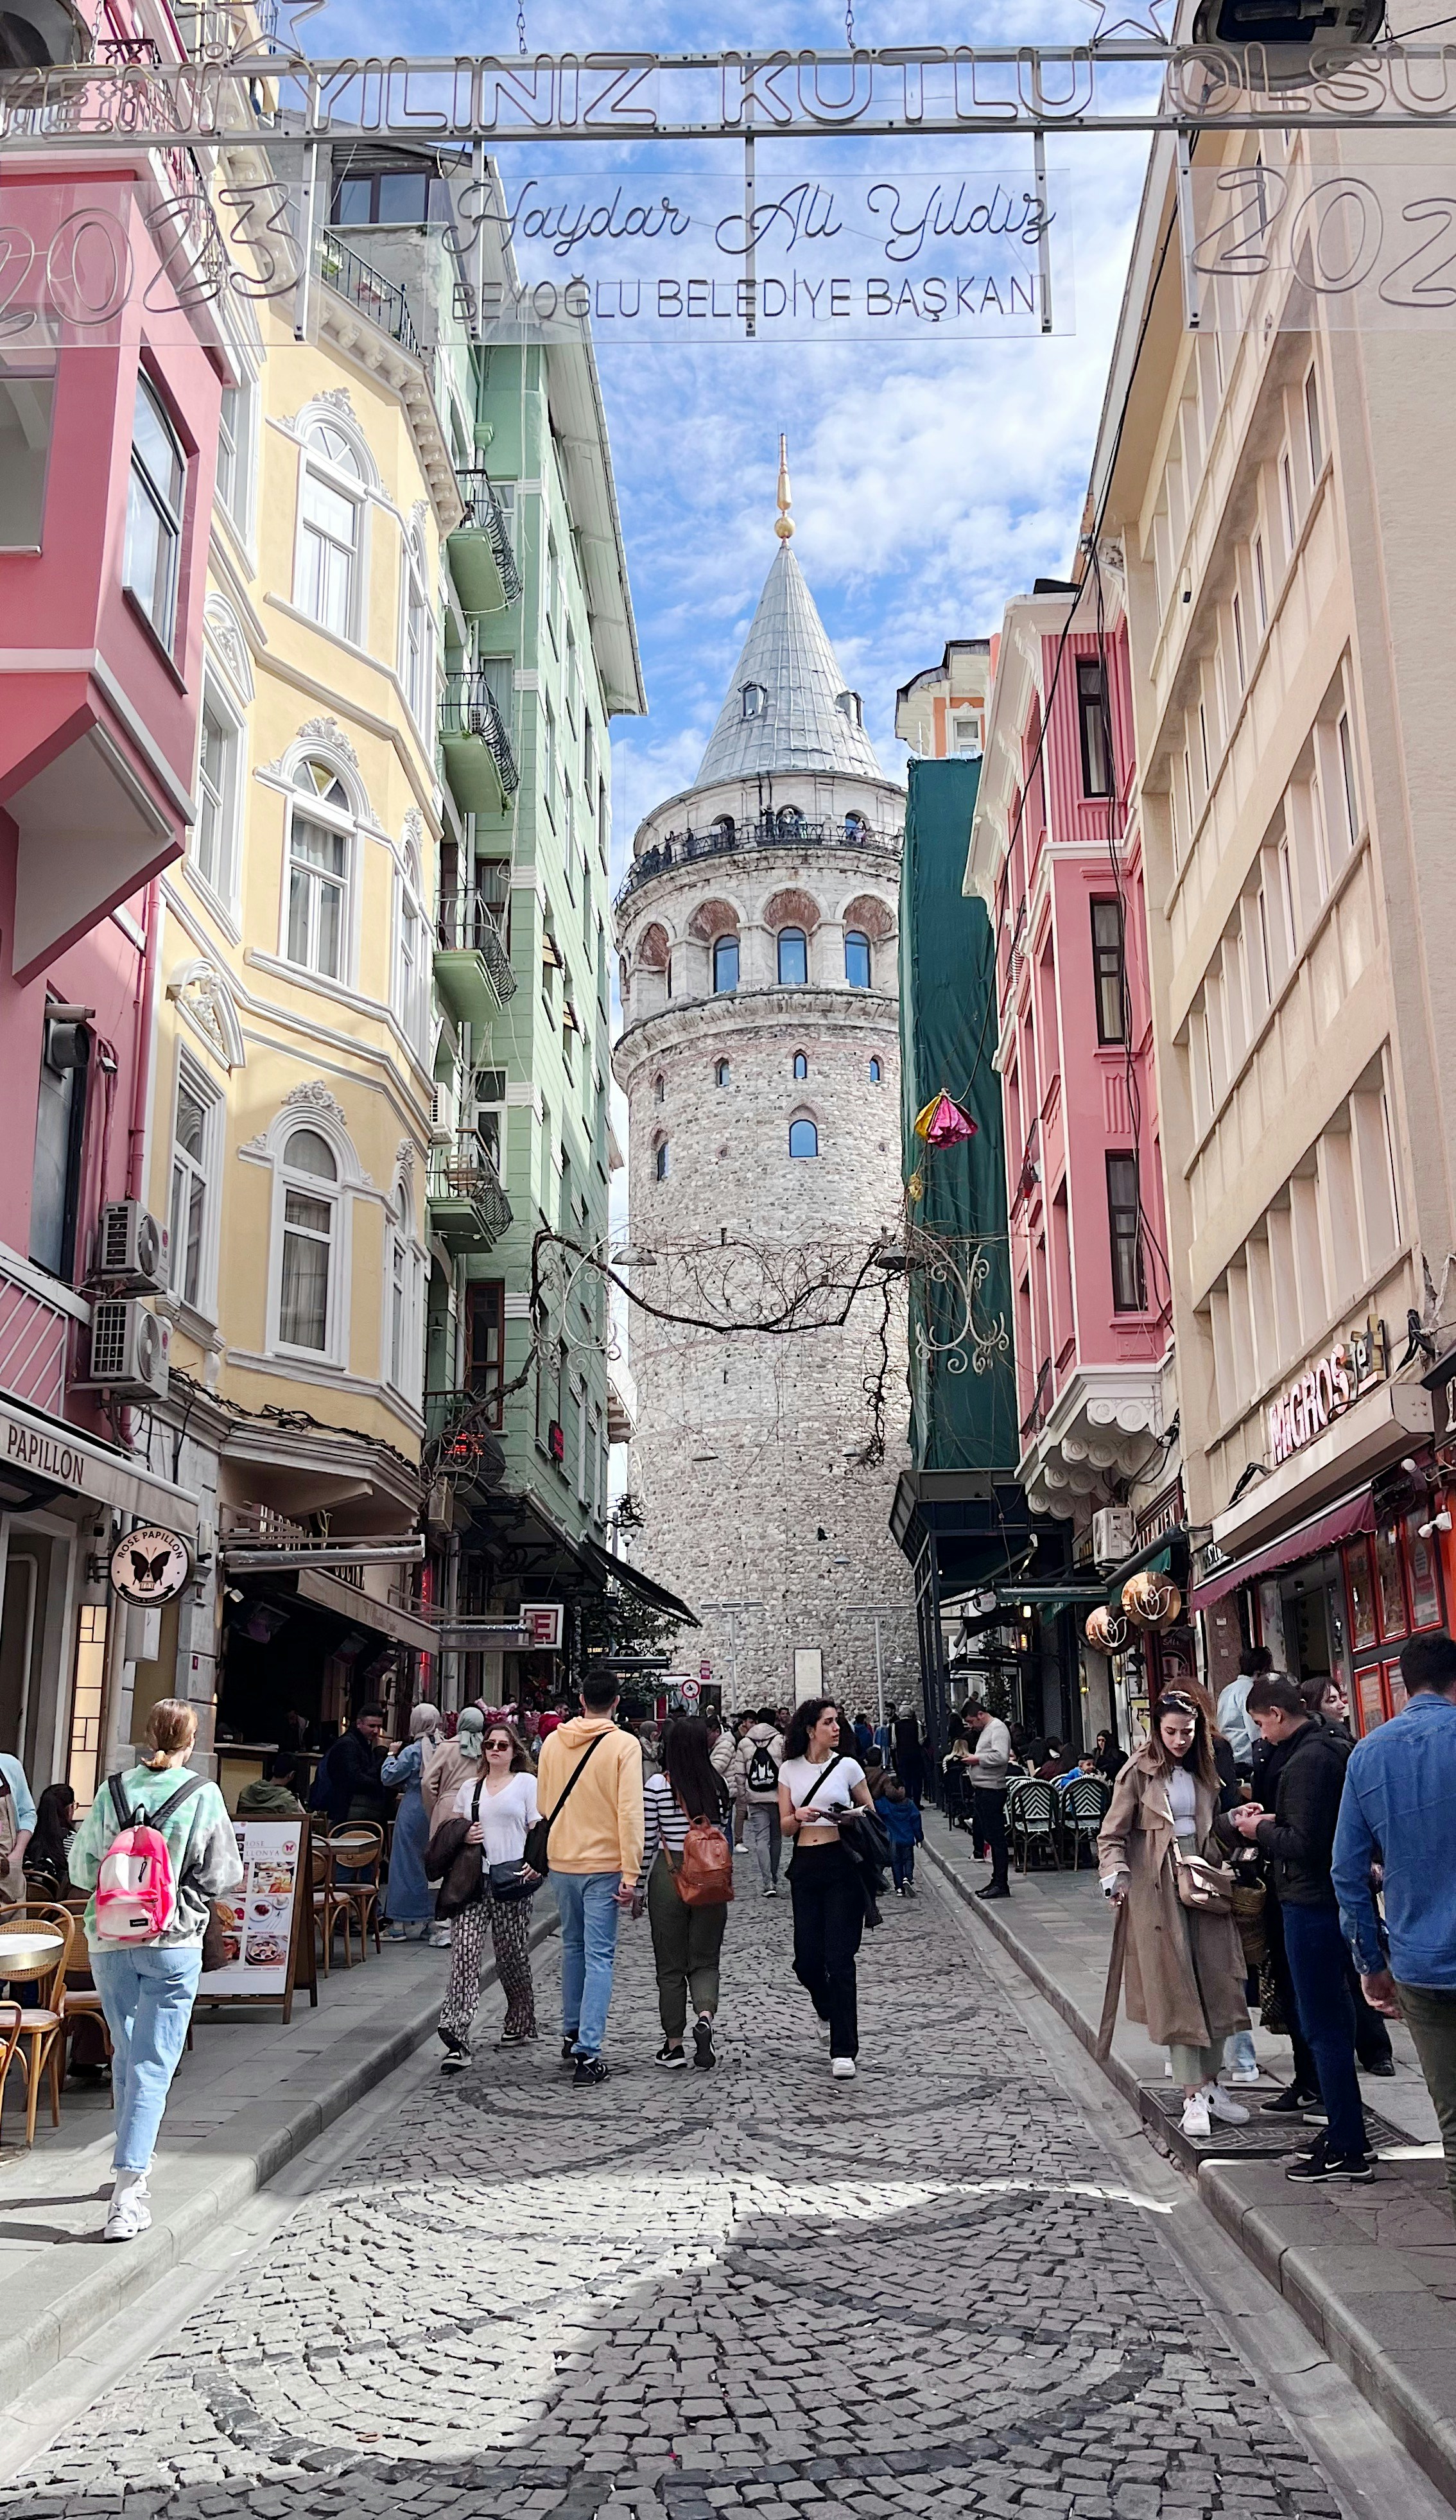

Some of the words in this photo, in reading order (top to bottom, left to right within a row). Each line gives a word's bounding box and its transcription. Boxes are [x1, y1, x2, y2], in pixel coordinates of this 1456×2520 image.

[289, 52, 657, 132] YILINIZ
[723, 46, 1094, 125] KUTLU
[442, 181, 691, 257] Haydar
[452, 273, 641, 324] BEYOĞLU
[7, 1424, 84, 1486] PAPILLON
[117, 1534, 140, 1559] ROSE
[143, 1531, 184, 1560] PAPILLON
